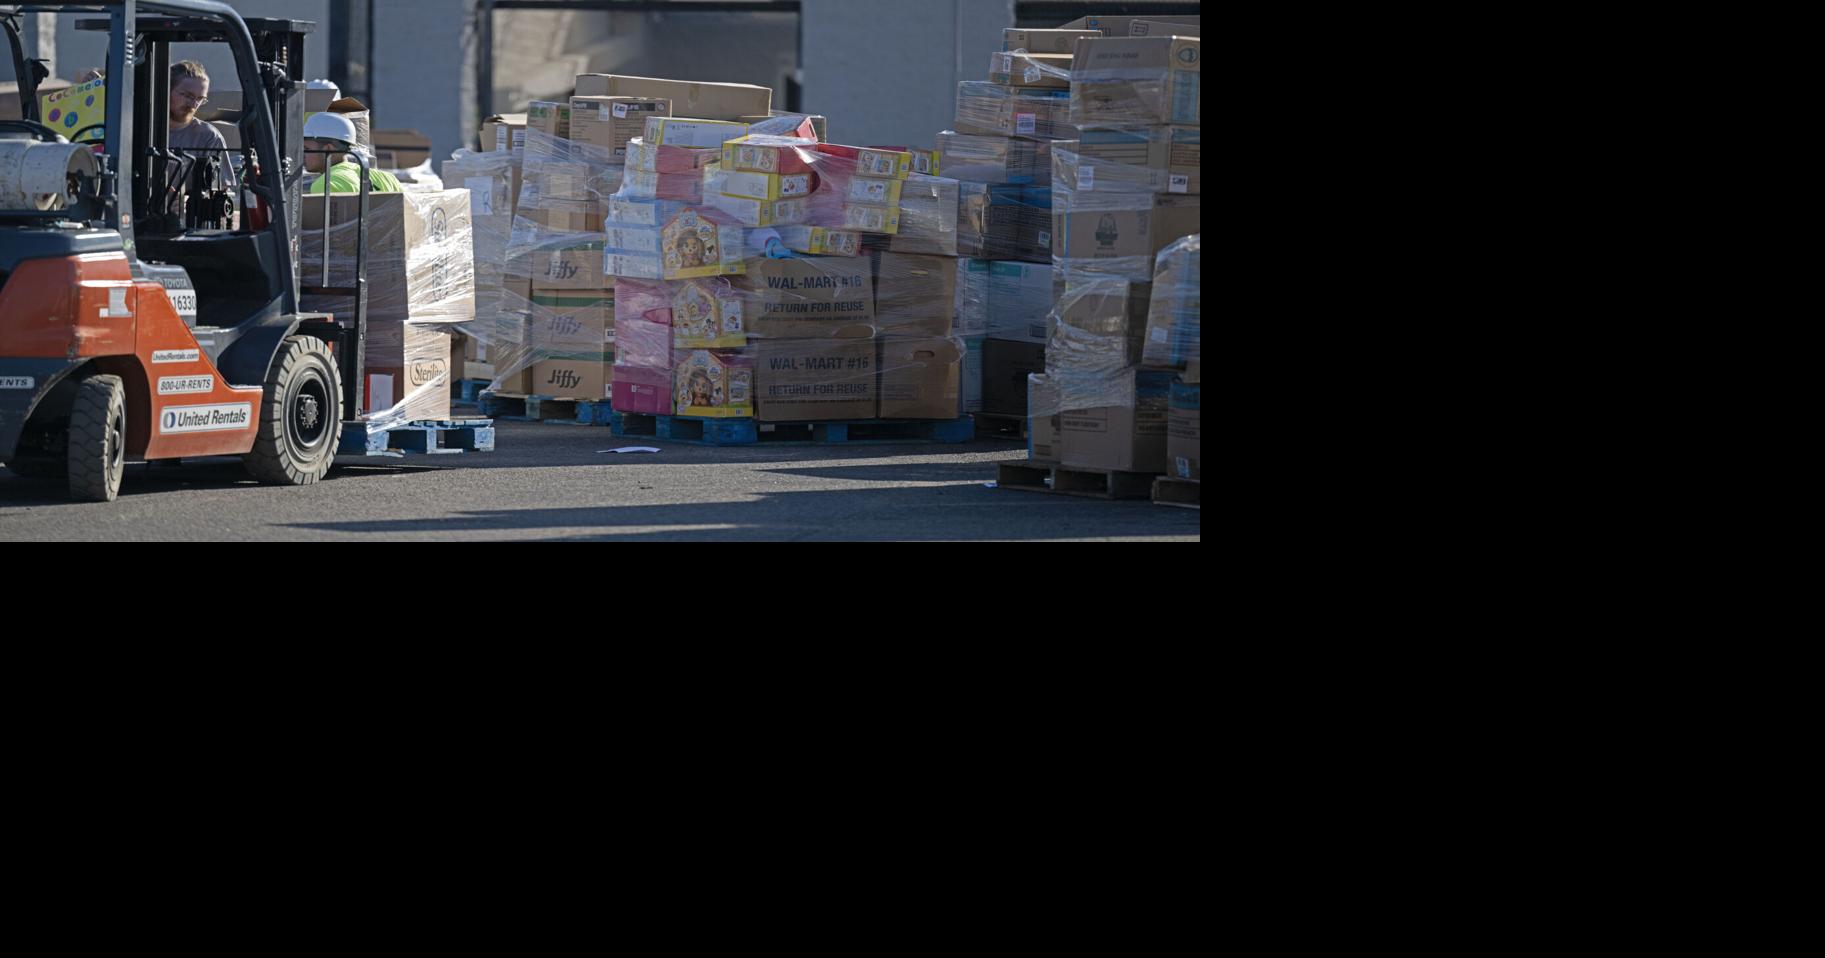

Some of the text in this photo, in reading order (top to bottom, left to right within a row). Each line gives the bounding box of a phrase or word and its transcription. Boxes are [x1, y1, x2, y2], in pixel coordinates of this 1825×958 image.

[544, 260, 578, 279] Jiffy
[163, 278, 187, 288] TOYOTA
[768, 275, 863, 289] WAL-MART #16
[168, 295, 196, 311] 16330
[765, 301, 865, 313] RETURN FOR REUSE
[547, 315, 582, 335] Jiffy
[769, 356, 869, 370] WAL-MART #16
[160, 378, 211, 391] 800-UR-RENTS
[547, 369, 580, 389] Jiffy
[769, 383, 868, 395] RETURN FOR REUSE
[177, 408, 247, 427] United Rentals
